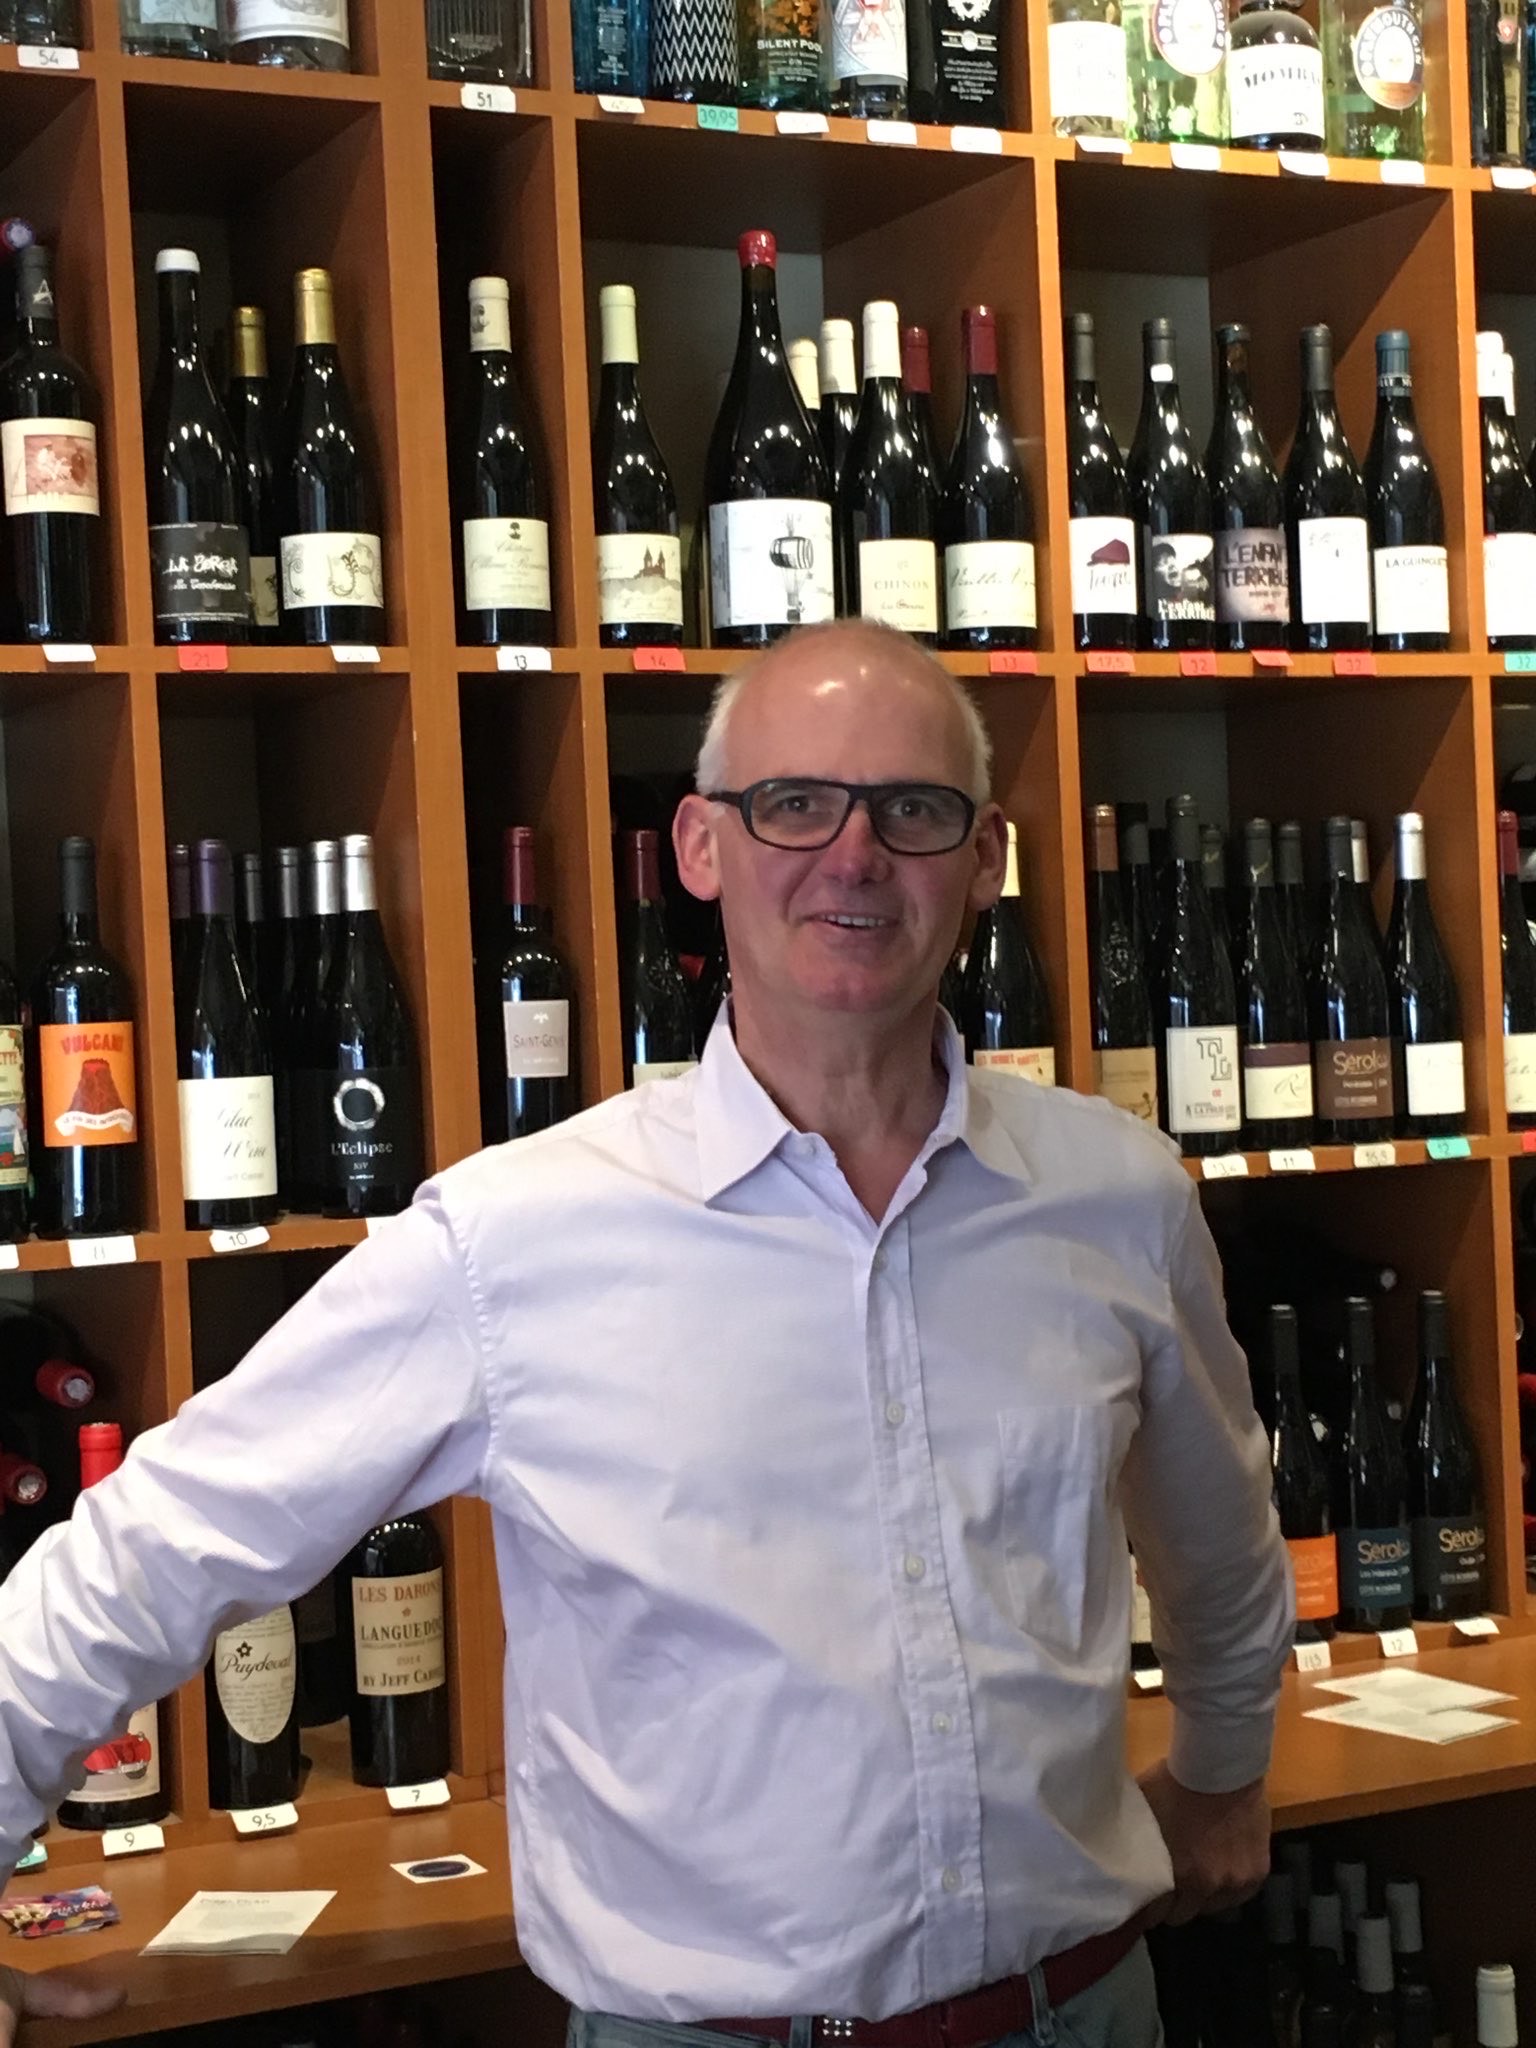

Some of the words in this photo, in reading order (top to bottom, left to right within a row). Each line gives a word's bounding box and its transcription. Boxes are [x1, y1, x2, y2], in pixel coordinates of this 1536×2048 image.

[757, 39, 798, 50] SILENT
[477, 91, 493, 108] 51
[873, 579, 929, 590] CHINON
[513, 654, 527, 670] 13
[229, 1232, 248, 1246] 10
[359, 1586, 388, 1602] LES
[410, 1789, 422, 1803] 7
[251, 1812, 277, 1829] 9,5
[124, 1831, 135, 1847] 9
